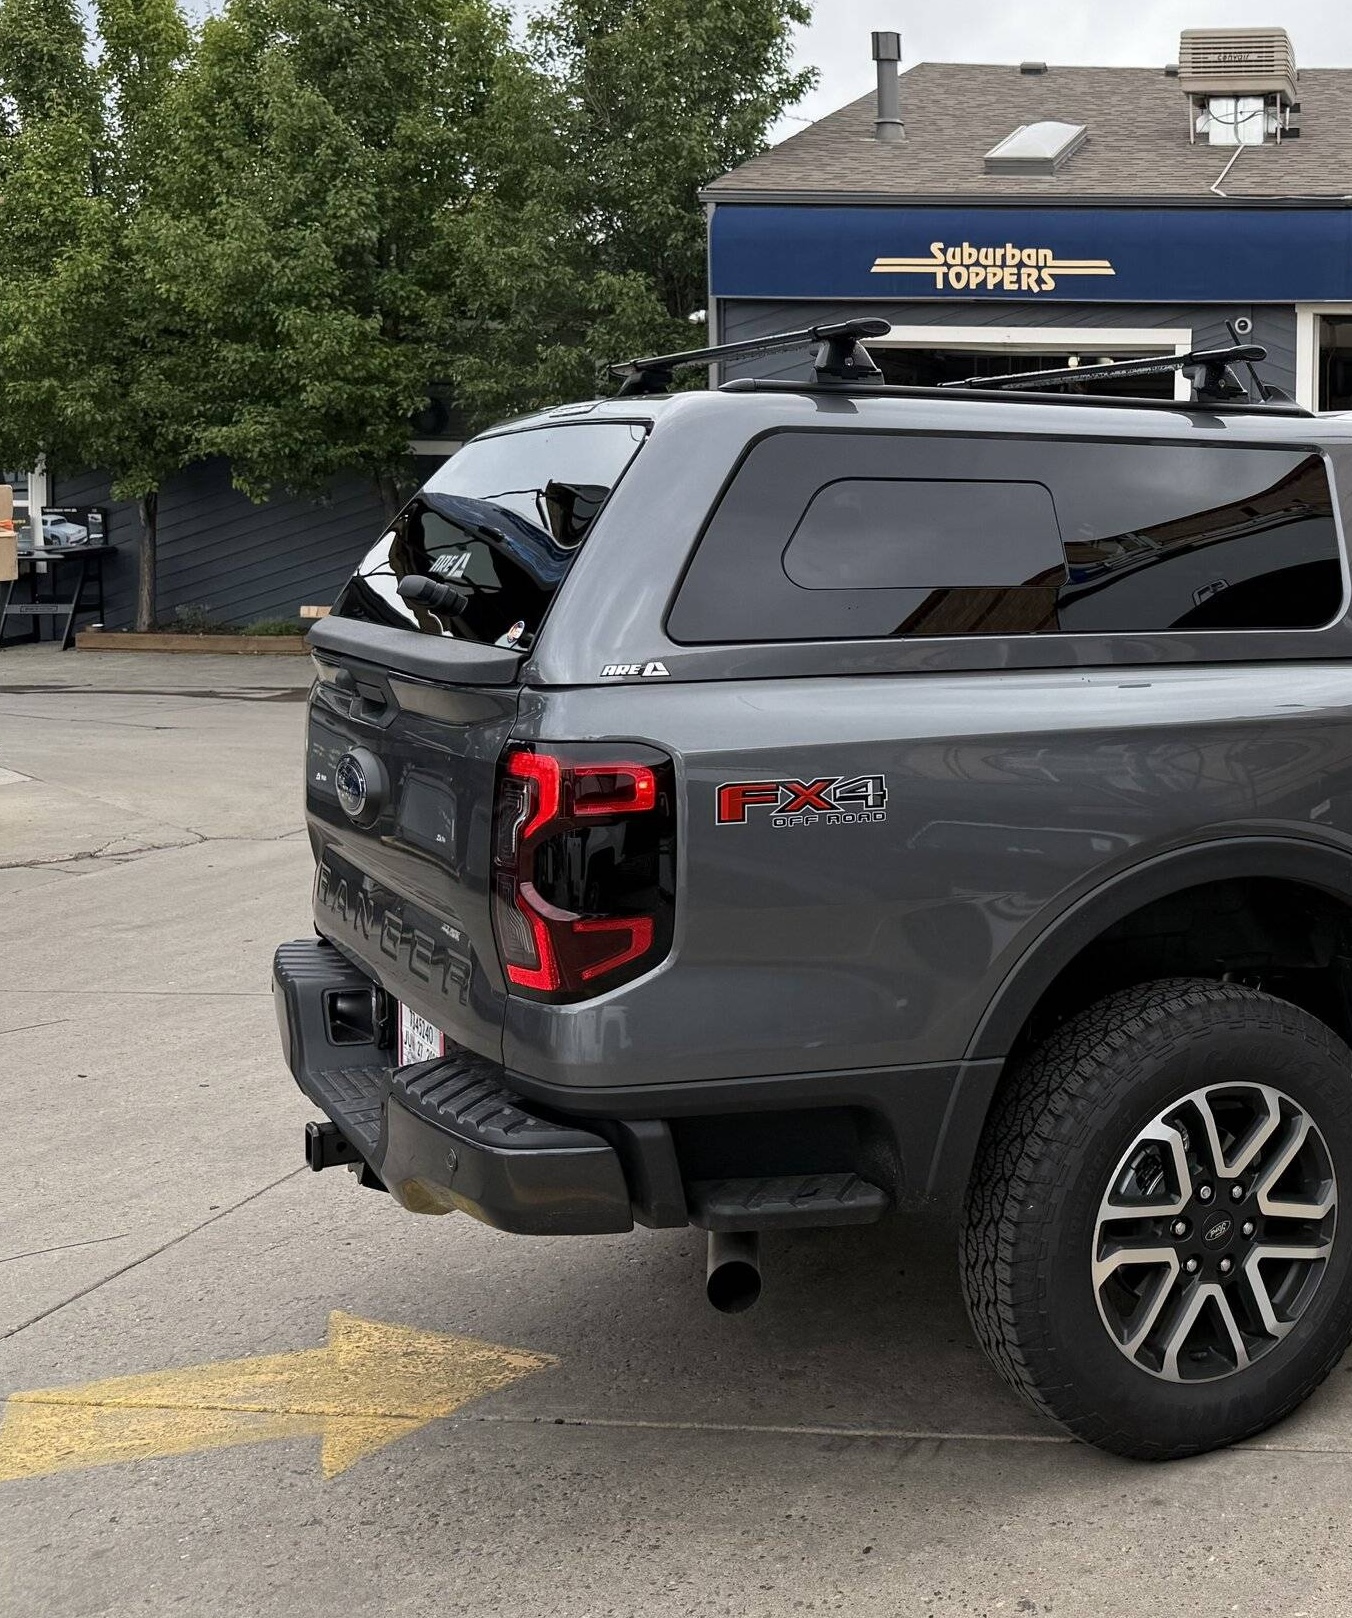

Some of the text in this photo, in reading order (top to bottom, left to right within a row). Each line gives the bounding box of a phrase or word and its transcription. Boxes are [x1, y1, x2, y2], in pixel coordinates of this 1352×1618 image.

[930, 242, 1054, 266] Suburban
[934, 266, 1056, 293] TOPPERS
[715, 774, 888, 826] FX4
[771, 811, 887, 829] OFF ROAD
[317, 862, 474, 1007] RANGER
